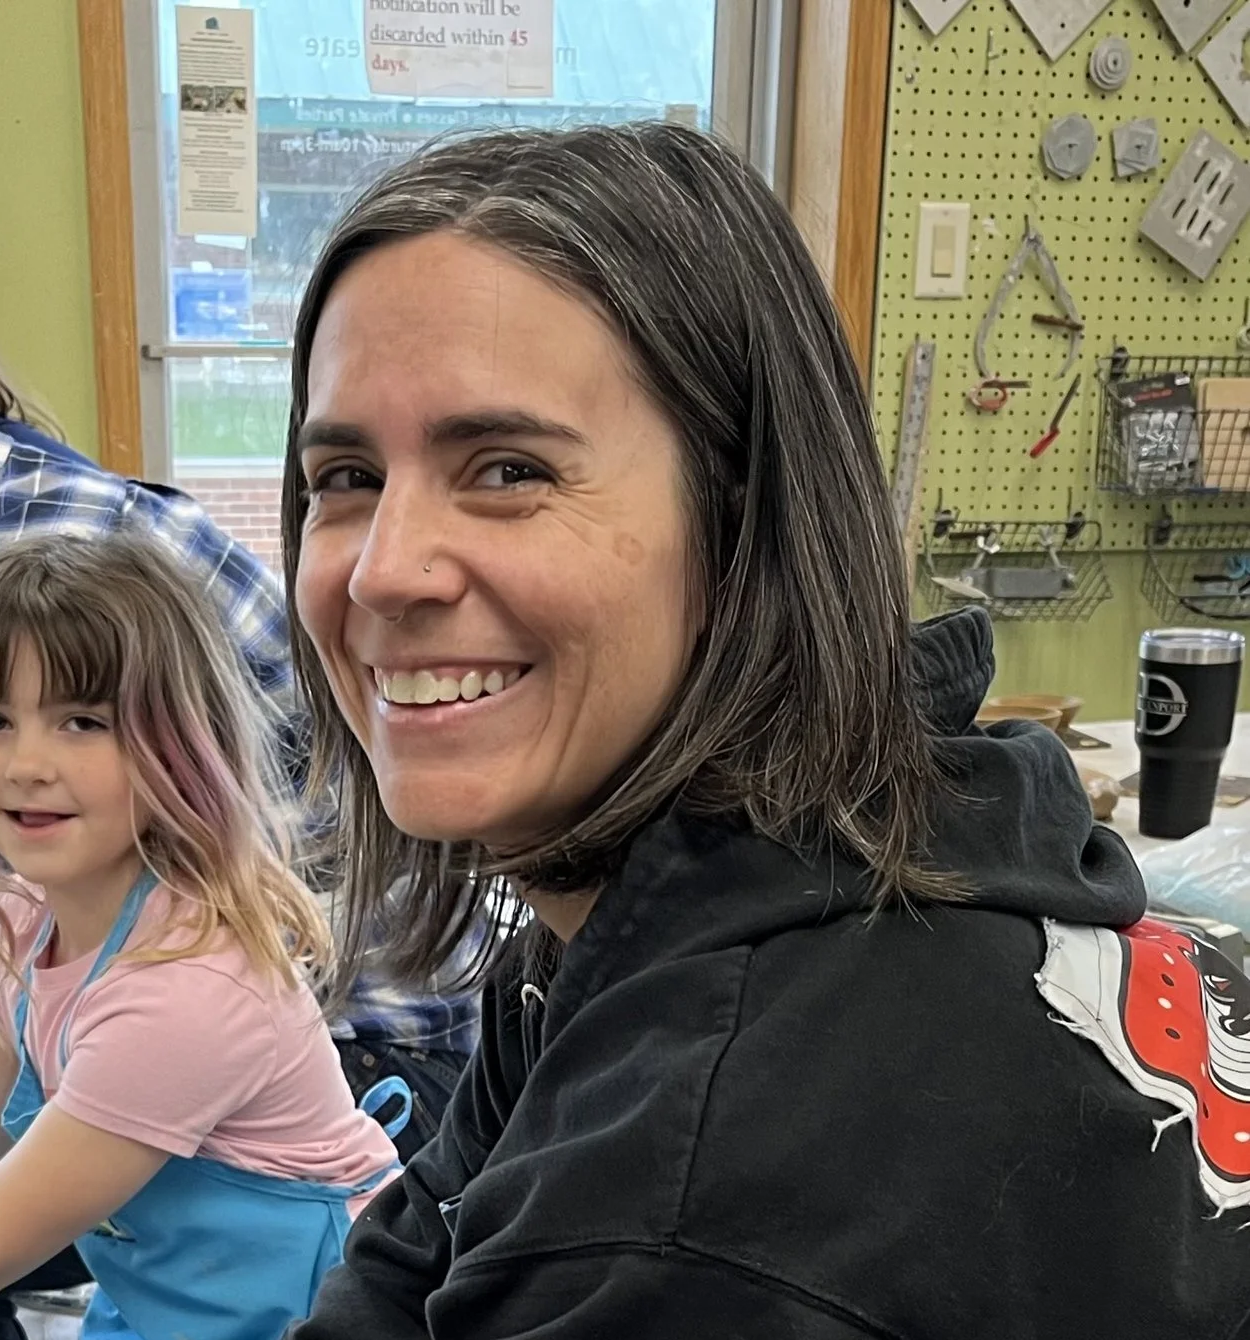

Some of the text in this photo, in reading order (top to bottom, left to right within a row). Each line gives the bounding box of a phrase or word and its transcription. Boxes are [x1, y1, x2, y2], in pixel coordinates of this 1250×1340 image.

[501, 0, 520, 16] be
[370, 24, 528, 46] discarded within 45
[372, 53, 410, 76] days.
